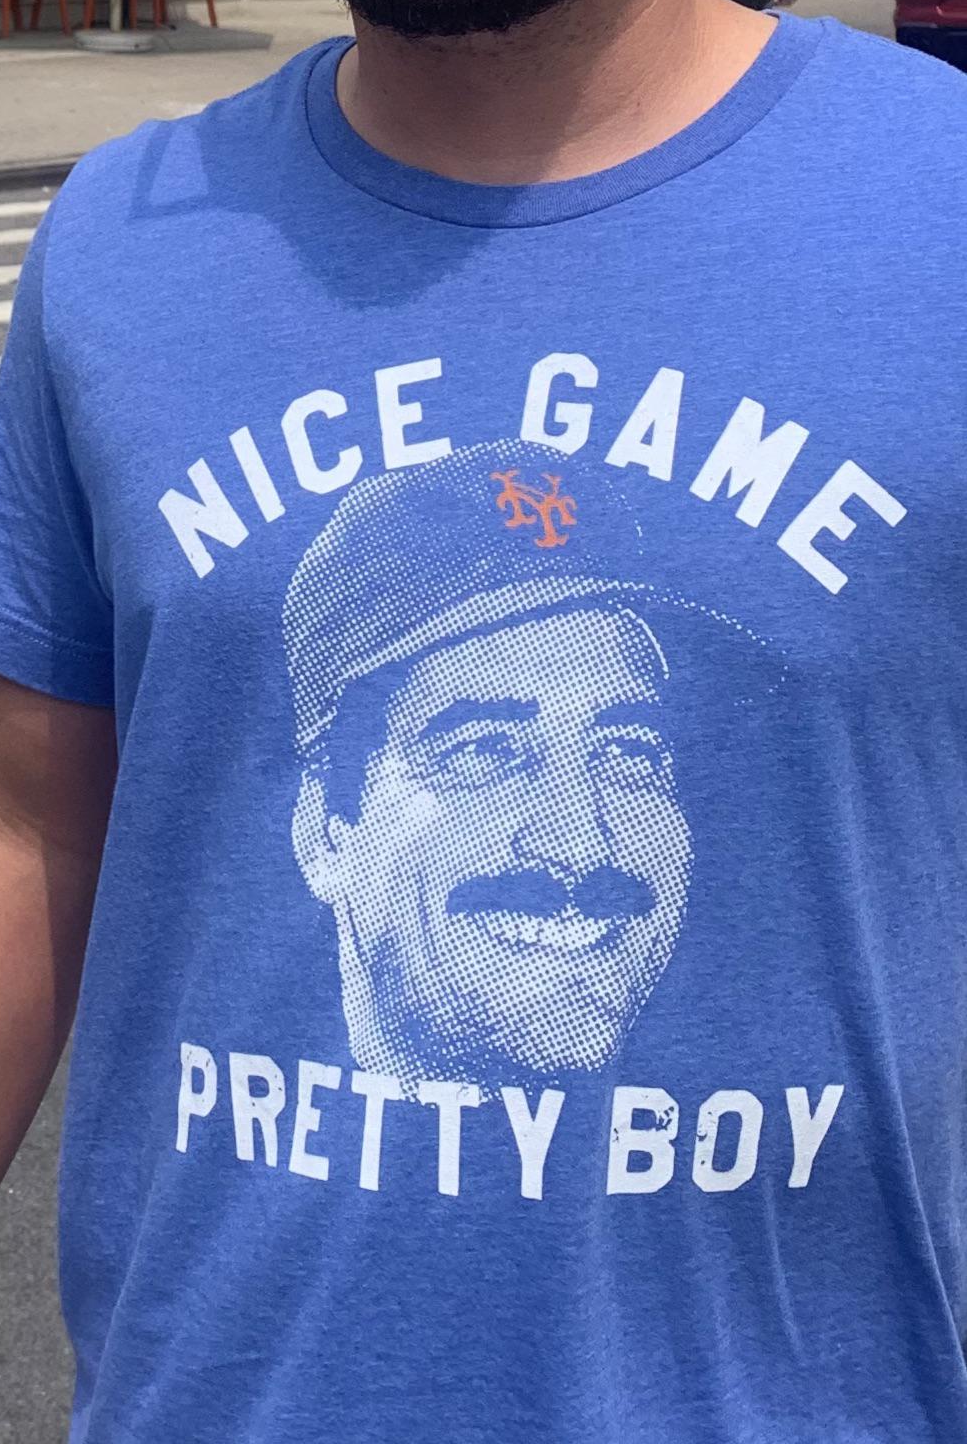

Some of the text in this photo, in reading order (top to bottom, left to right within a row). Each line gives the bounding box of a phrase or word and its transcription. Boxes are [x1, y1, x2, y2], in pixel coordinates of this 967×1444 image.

[157, 352, 908, 595] NICE GAME
[175, 1042, 845, 1201] PRETTY BOY
